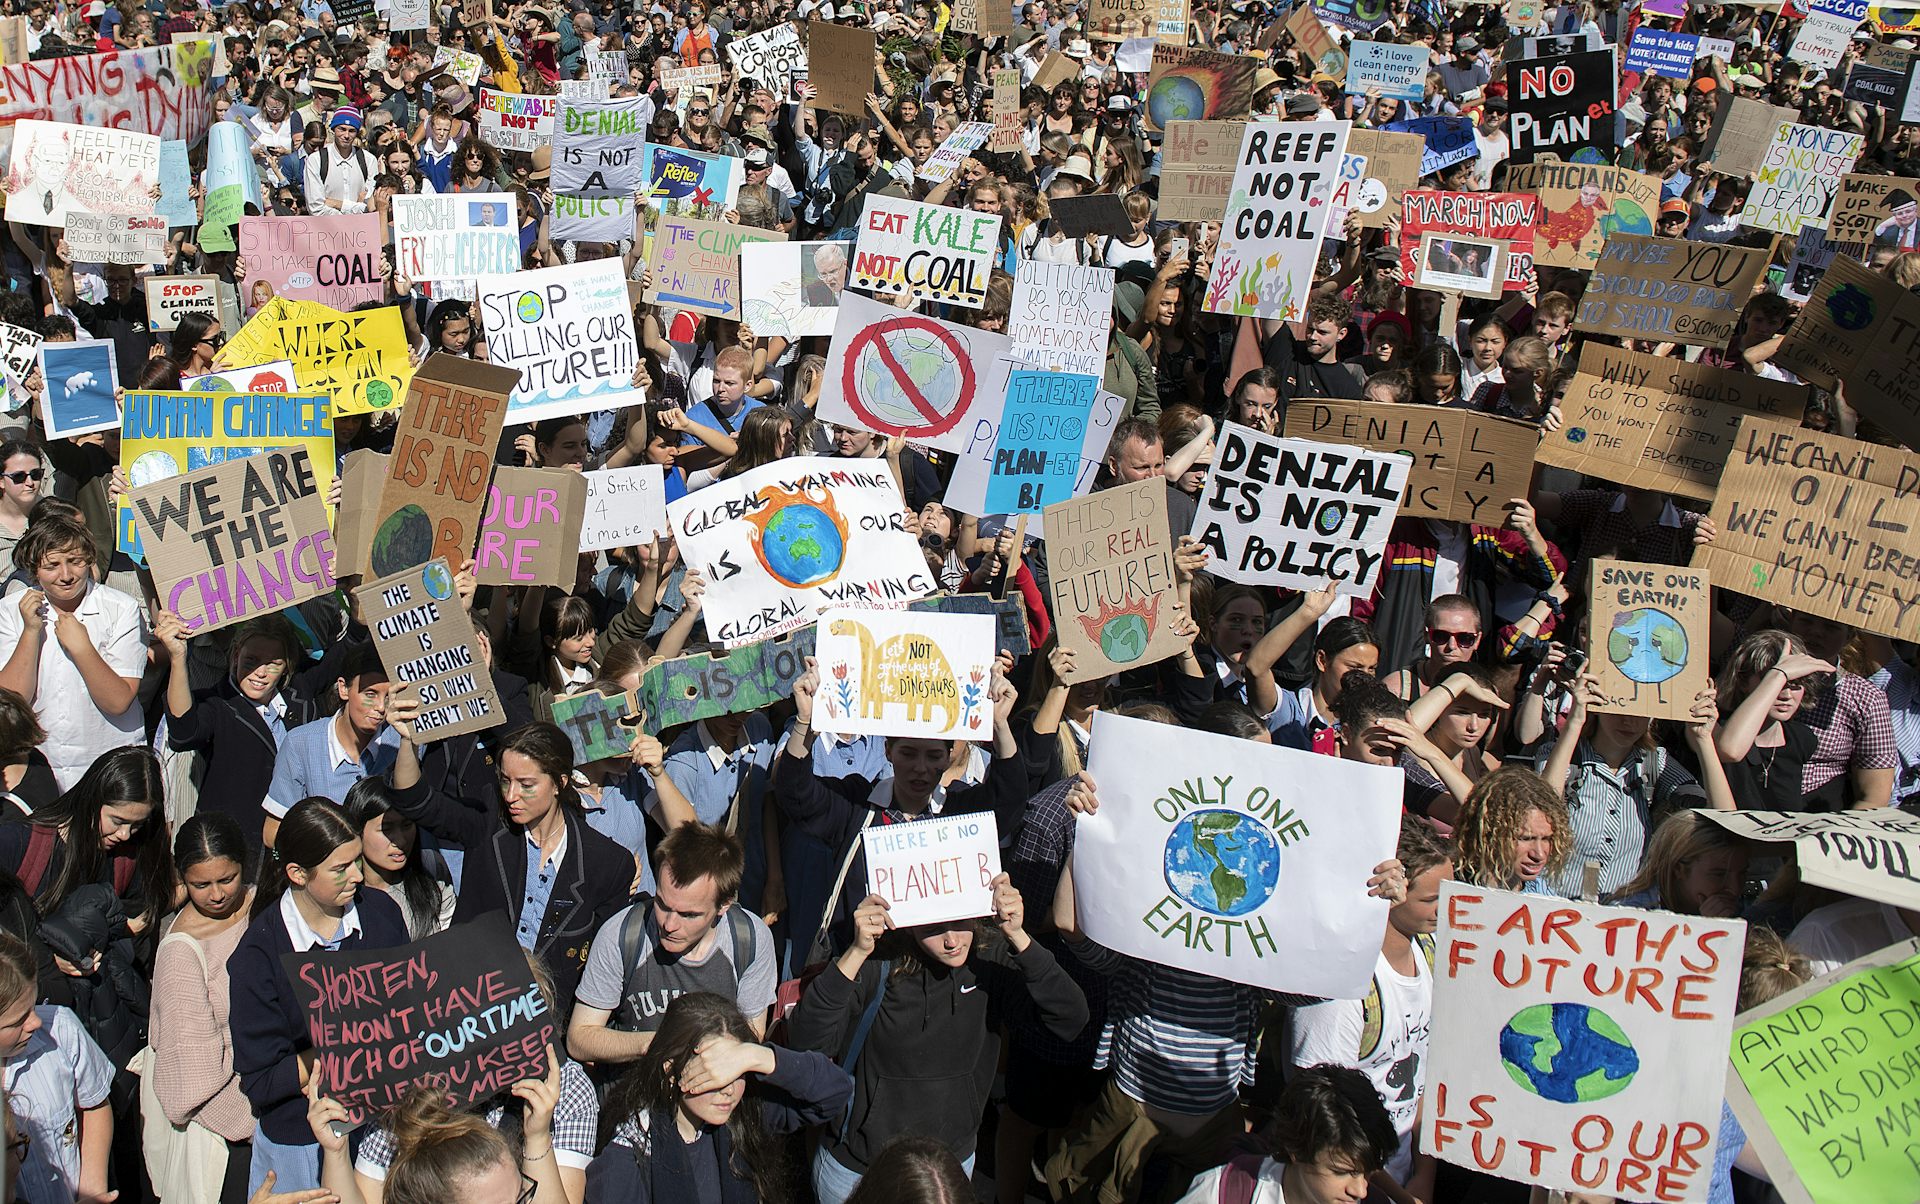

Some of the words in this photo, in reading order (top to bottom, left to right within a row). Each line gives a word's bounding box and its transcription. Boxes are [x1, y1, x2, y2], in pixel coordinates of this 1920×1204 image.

[468, 4, 486, 21] SIGN
[1161, 8, 1182, 16] OUR
[1314, 8, 1342, 21] VICTORIA
[1158, 22, 1184, 32] PLANET
[1807, 17, 1852, 34] AUSTRALIA
[731, 38, 760, 56] WE
[1154, 44, 1182, 58] ADANI
[1634, 34, 1656, 45] Save
[1658, 37, 1673, 47] the
[1675, 39, 1694, 51] kids
[1795, 42, 1839, 59] CLIMATE
[1816, 35, 1834, 45] VOTES
[1874, 47, 1904, 59] SAVE
[1154, 55, 1174, 64] THE
[1354, 60, 1381, 70] clean
[1384, 62, 1421, 75] energy
[1386, 50, 1388, 59] I
[1391, 51, 1412, 62] love
[1630, 48, 1649, 58] VOTE
[1658, 52, 1692, 64] CLIMATE
[996, 72, 1019, 87] PEACE
[1361, 72, 1380, 81] and
[1383, 74, 1385, 82] I
[1388, 76, 1410, 84] vote
[1520, 65, 1575, 100] NO
[1855, 80, 1874, 90] COAL
[1874, 83, 1895, 95] KILLS
[502, 114, 538, 130] NOT
[565, 106, 641, 135] DENIAL
[971, 124, 994, 136] THE
[995, 112, 1019, 128] CLIMATE
[1218, 125, 1241, 138] ARE
[73, 129, 118, 150] FEEL
[121, 136, 155, 155] THE
[480, 126, 525, 148] FOSSIL
[946, 136, 980, 150] WORLD
[1245, 130, 1337, 166] REEF
[73, 146, 114, 167] HEAT
[120, 152, 157, 171] YET?
[564, 147, 582, 166] IS
[599, 147, 635, 166] NOT
[1765, 144, 1785, 166] IS
[581, 171, 608, 191] A
[662, 162, 699, 182] Reflex
[1186, 175, 1231, 194] TIME
[1776, 170, 1804, 191] ON
[1249, 172, 1320, 202] NOT
[1844, 179, 1888, 194] WAKE
[555, 194, 627, 219] POLICY
[1405, 197, 1482, 228] MARCH
[1489, 201, 1536, 227] NOW
[1761, 188, 1818, 214] DEAD
[1846, 198, 1869, 211] UP
[66, 214, 103, 230] DON'T
[398, 198, 455, 232] JOSH
[1235, 208, 1314, 241] COAL
[1833, 212, 1881, 230] SCOTT
[67, 230, 101, 243] MODE
[107, 234, 121, 244] ON
[123, 233, 139, 244] THE
[665, 224, 695, 244] THE
[869, 211, 908, 235] EAT
[912, 207, 997, 255] KALE
[68, 249, 144, 263] ENVIRONMENT
[663, 248, 676, 260] IS
[1602, 242, 1676, 264] MAYBE
[270, 253, 315, 271] MAKE
[316, 253, 382, 288] COAL
[672, 271, 708, 296] WHY
[856, 251, 901, 279] NOT
[903, 250, 986, 296] COAL
[1017, 260, 1113, 294] POLITICIANS
[160, 296, 215, 308] CLIMATE
[163, 285, 204, 297] STOP
[1028, 287, 1046, 303] DO
[1056, 291, 1090, 310] YOUR
[1664, 284, 1688, 303] GO
[1692, 286, 1735, 310] BACK
[1022, 302, 1110, 330] SCIENCE
[1582, 300, 1608, 324] TO
[6, 325, 41, 347] THAT
[487, 322, 580, 365] KILLING
[587, 314, 631, 342] OUR
[1056, 351, 1098, 375] CHANGE
[1014, 376, 1092, 408] THERE
[1601, 358, 1650, 389] WHY
[1664, 374, 1740, 401] SHOULD
[1589, 384, 1612, 400] GO
[1623, 393, 1648, 407] TO
[1656, 402, 1708, 417] SCHOOL
[123, 395, 214, 439] HUMAN
[223, 395, 333, 439] CHANGE
[411, 384, 500, 447] THERE
[1008, 413, 1036, 441] IS
[1577, 404, 1613, 421] YOU
[1666, 425, 1720, 444] LISTEN
[1311, 405, 1495, 456] DENIAL
[1594, 433, 1622, 448] THE
[392, 435, 434, 488] IS
[435, 446, 491, 503] NO
[1219, 432, 1400, 502] DENIAL
[135, 475, 225, 542] WE
[241, 450, 317, 513] ARE
[607, 473, 649, 494] Strike
[1017, 482, 1044, 511] B!
[595, 500, 609, 520] 4
[682, 491, 771, 537] GLOBAL
[779, 470, 892, 493] WARMING
[1047, 498, 1115, 539] THIS
[1125, 485, 1155, 521] IS
[1208, 474, 1263, 524] IS
[1280, 493, 1381, 540] NOT
[859, 513, 904, 532] OUR
[191, 506, 289, 567] THE
[1058, 541, 1100, 573] OUR
[1107, 524, 1159, 560] REAL
[1199, 522, 1228, 561] A
[1238, 535, 1382, 586] POLICY
[168, 529, 338, 630] CHANGE
[819, 574, 926, 602] WARNING
[1053, 551, 1173, 617] FUTURE!
[1602, 568, 1654, 587] SAVE
[1664, 574, 1700, 591] OUR
[382, 582, 411, 609] THE
[1617, 588, 1688, 611] EARTH!
[375, 602, 440, 642] CLIMATE
[717, 597, 807, 642] GLOBAL
[416, 631, 433, 652] IS
[909, 641, 932, 660] NOT
[395, 644, 473, 682] CHANGING
[418, 685, 441, 705] SO
[442, 672, 478, 698] WHY
[413, 705, 463, 733] AREN'T
[1153, 775, 1234, 823] ONLY
[1246, 786, 1310, 847] ONE
[869, 831, 928, 854] THERE
[938, 827, 948, 843] IS
[958, 824, 979, 839] NO
[874, 856, 963, 903] PLANET
[977, 853, 992, 887] B
[1142, 895, 1279, 959] EARTH
[1448, 894, 1730, 975] EARTH'S
[1448, 939, 1717, 1021] FUTURE
[422, 969, 521, 1028] HAVE
[1739, 1005, 1824, 1063] AND
[1840, 974, 1892, 1015] ON
[320, 1047, 382, 1092] MUCH
[1760, 1027, 1868, 1088] THIRD
[1785, 1079, 1860, 1136] WAS
[1437, 1082, 1497, 1129] IS
[1571, 1114, 1710, 1170] OUR
[1433, 1118, 1697, 1202] FUTURE
[1819, 1127, 1865, 1179] BY
